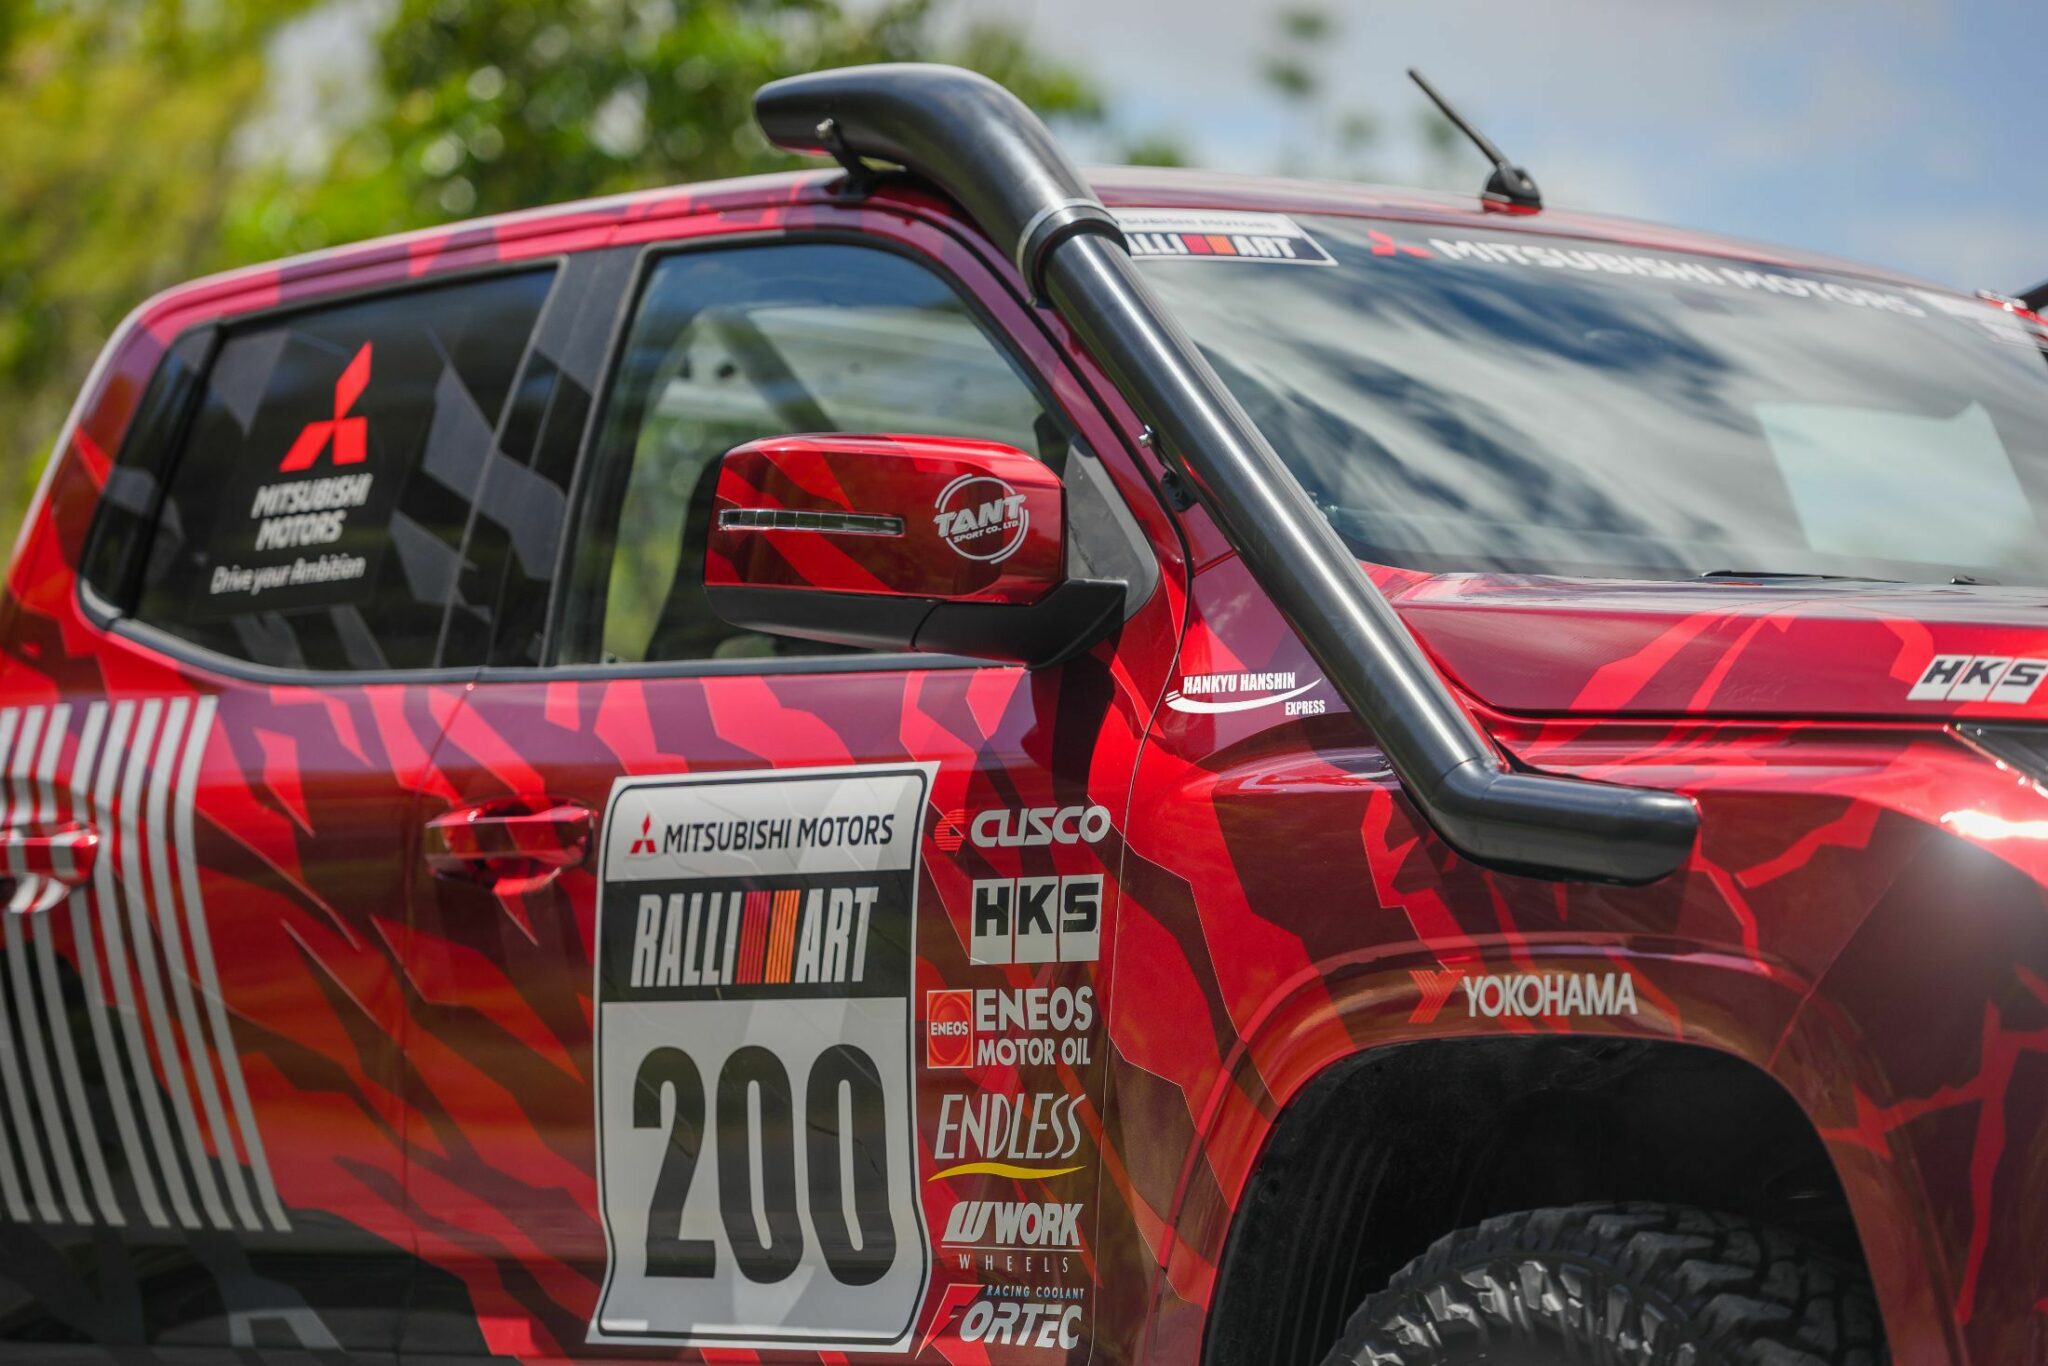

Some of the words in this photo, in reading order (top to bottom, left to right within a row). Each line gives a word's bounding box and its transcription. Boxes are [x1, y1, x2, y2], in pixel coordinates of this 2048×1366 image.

[1428, 238, 1726, 286] MITSUBISHI
[1718, 267, 1927, 318] MOTORS
[251, 473, 373, 519] MITSUBISHI
[933, 494, 1026, 538] TANT
[255, 509, 347, 551] MOTORS
[953, 529, 984, 543] SPORT
[210, 564, 254, 594] Drive
[251, 565, 291, 596] your
[289, 552, 366, 585] Ambition
[1182, 674, 1237, 695] HANKYU
[1240, 672, 1296, 692] HANSHIN
[1921, 659, 2048, 687] HKS
[1285, 700, 1326, 716] EXPRESS
[664, 817, 792, 854] MITSUBISHI
[796, 814, 895, 848] MOTORS
[970, 805, 1112, 848] CUSCO
[974, 882, 1100, 938] HKS
[975, 986, 1093, 1031] ENEOS
[1463, 972, 1639, 1018] YOKOHAMA
[930, 1021, 969, 1036] ENEOS
[976, 1037, 1056, 1067] MOTOR
[1061, 1037, 1092, 1066] OIL
[934, 1093, 1086, 1160] ENDLESS
[633, 1043, 897, 1287] 200
[994, 1202, 1084, 1246] WORK
[958, 1253, 1069, 1273] WHEELS
[986, 1285, 1031, 1297] RACING
[1036, 1286, 1085, 1300] COOLANT
